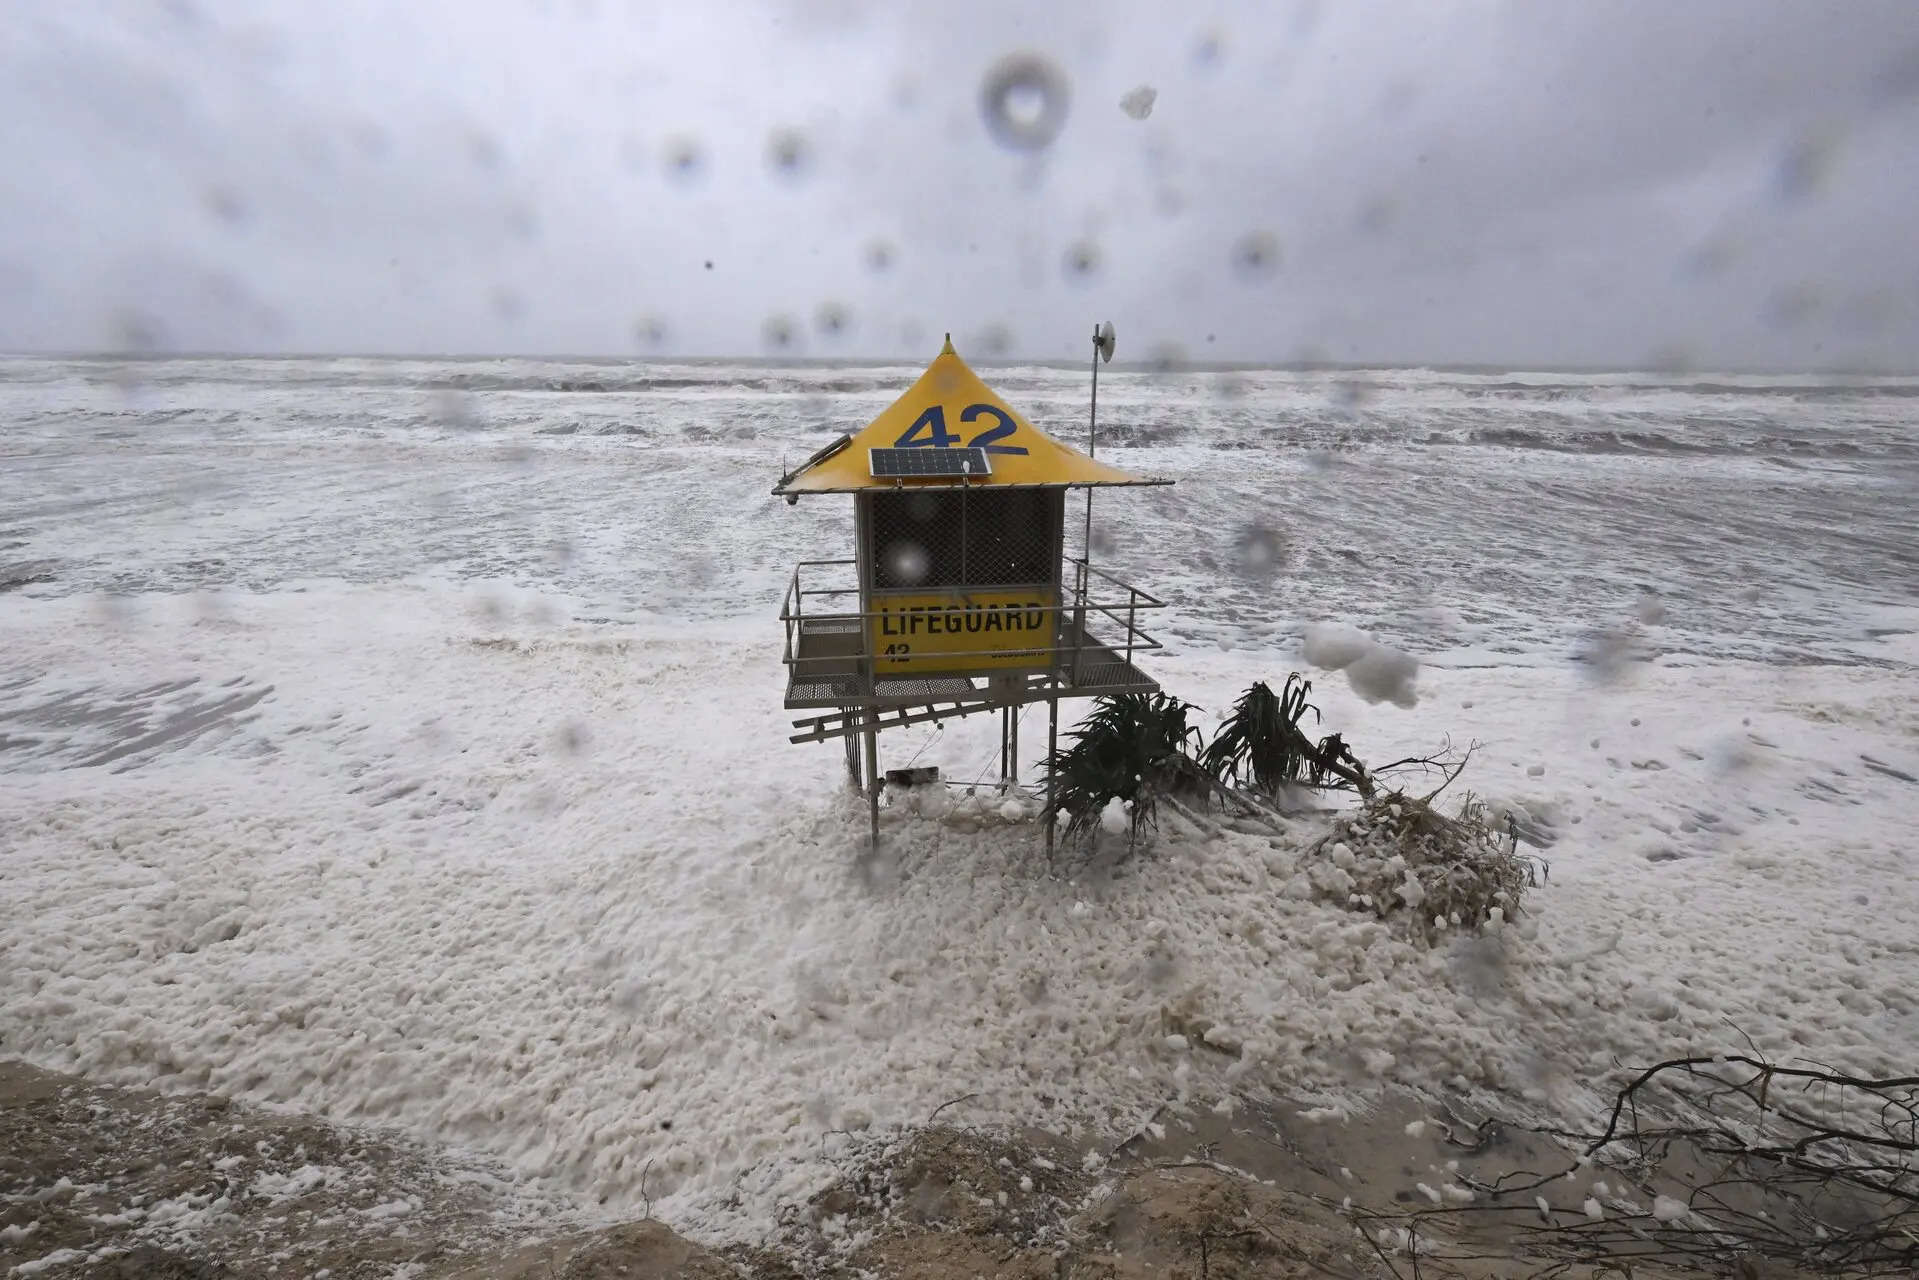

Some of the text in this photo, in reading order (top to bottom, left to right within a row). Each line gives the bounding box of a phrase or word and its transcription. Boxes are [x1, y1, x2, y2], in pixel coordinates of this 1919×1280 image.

[894, 404, 1029, 456] 42
[882, 603, 1044, 635] LIFEGUARD
[885, 643, 910, 662] 42
